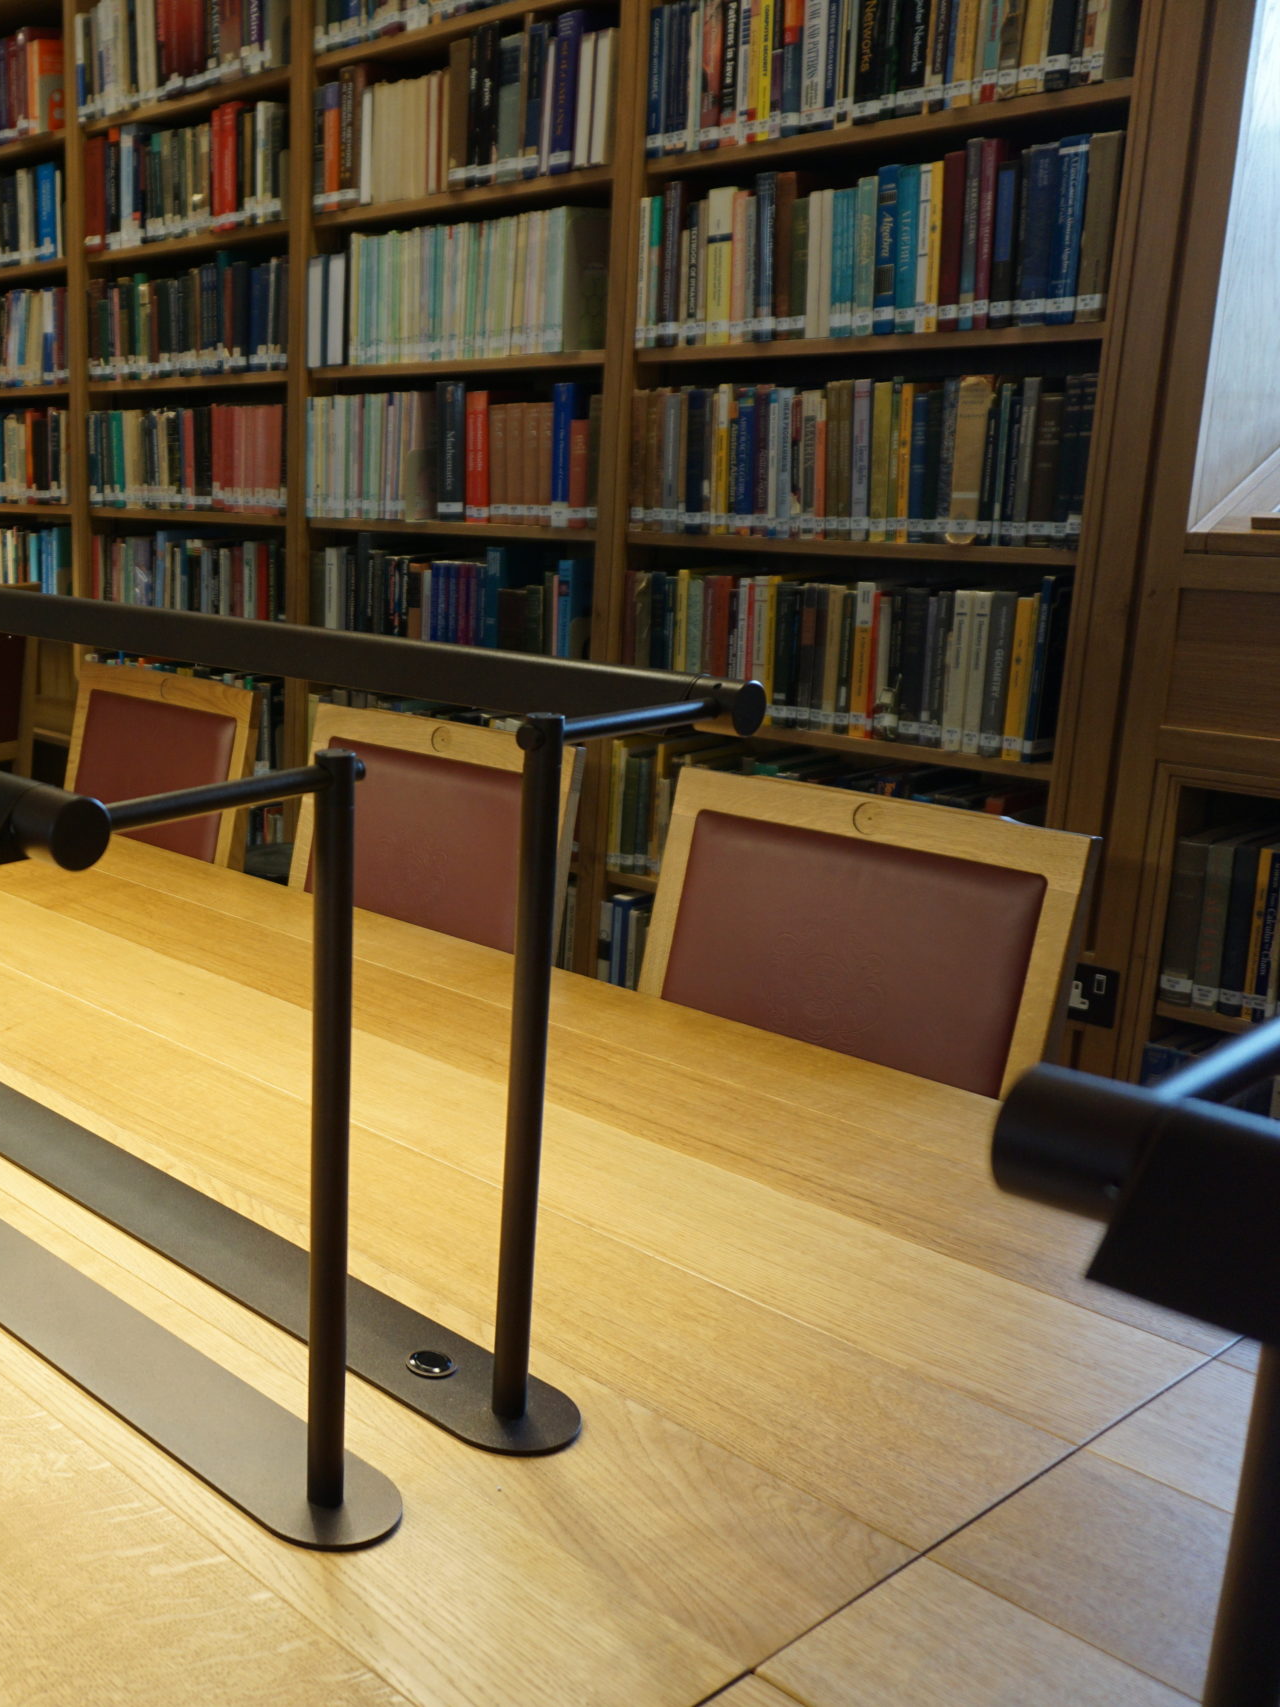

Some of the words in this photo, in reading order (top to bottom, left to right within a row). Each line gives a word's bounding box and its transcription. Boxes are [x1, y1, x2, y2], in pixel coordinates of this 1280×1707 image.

[210, 0, 220, 54] ARCH'S
[250, 0, 261, 41] Atkins
[726, 1, 738, 46] Patterns
[808, 24, 820, 39] AND
[829, 3, 837, 34] INTEGER
[860, 0, 878, 72] Networks
[726, 48, 734, 59] in
[806, 41, 820, 80] PATTERNS
[826, 35, 835, 88] PROGRAMMING
[910, 26, 925, 73] Networks
[724, 62, 734, 84] Java
[880, 212, 894, 258] Algebra
[690, 267, 696, 277] OF
[782, 398, 790, 420] LINEAR
[446, 431, 455, 490] Mathematics
[781, 422, 789, 473] PROGRAMMING
[804, 420, 814, 467] MATRIX
[991, 648, 1003, 698] GEOMETRY
[1264, 908, 1276, 941] Calculus
[1259, 951, 1270, 976] Chaos
